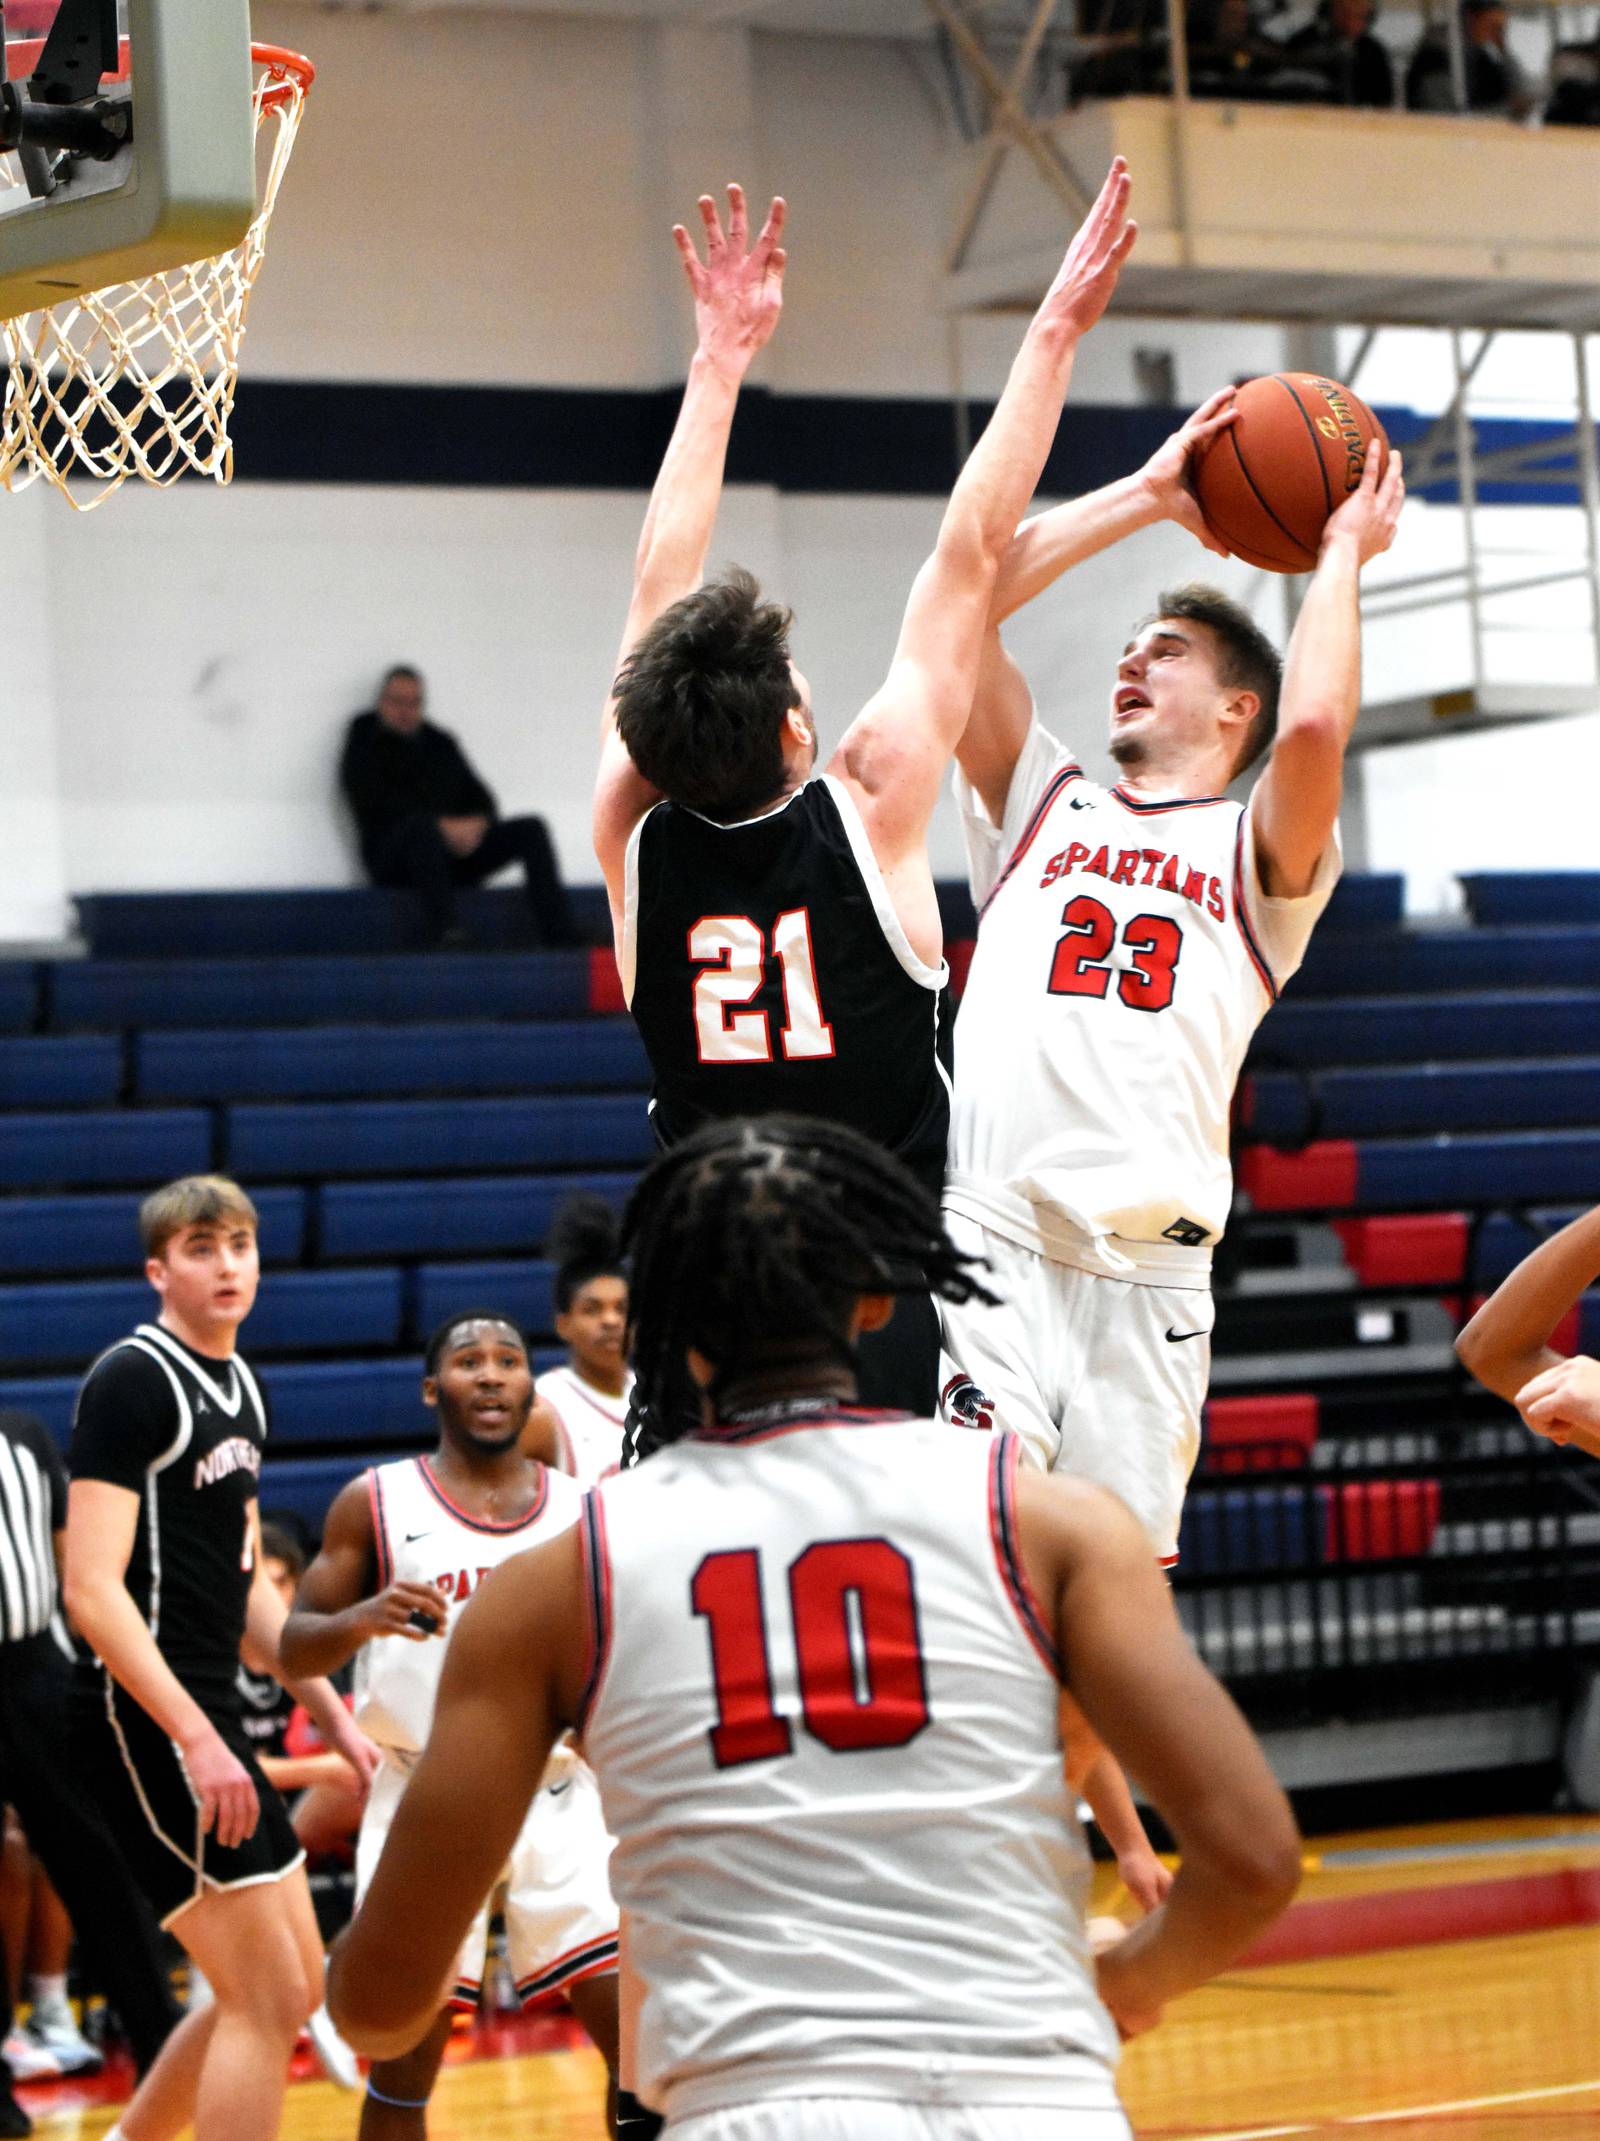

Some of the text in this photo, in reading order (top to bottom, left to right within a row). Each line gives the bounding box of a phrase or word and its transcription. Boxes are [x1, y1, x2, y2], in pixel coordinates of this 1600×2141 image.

[1040, 841, 1225, 923] SPARTANS
[687, 905, 836, 1063] 21
[1047, 894, 1184, 1013] 23
[691, 1537, 932, 1769] 10
